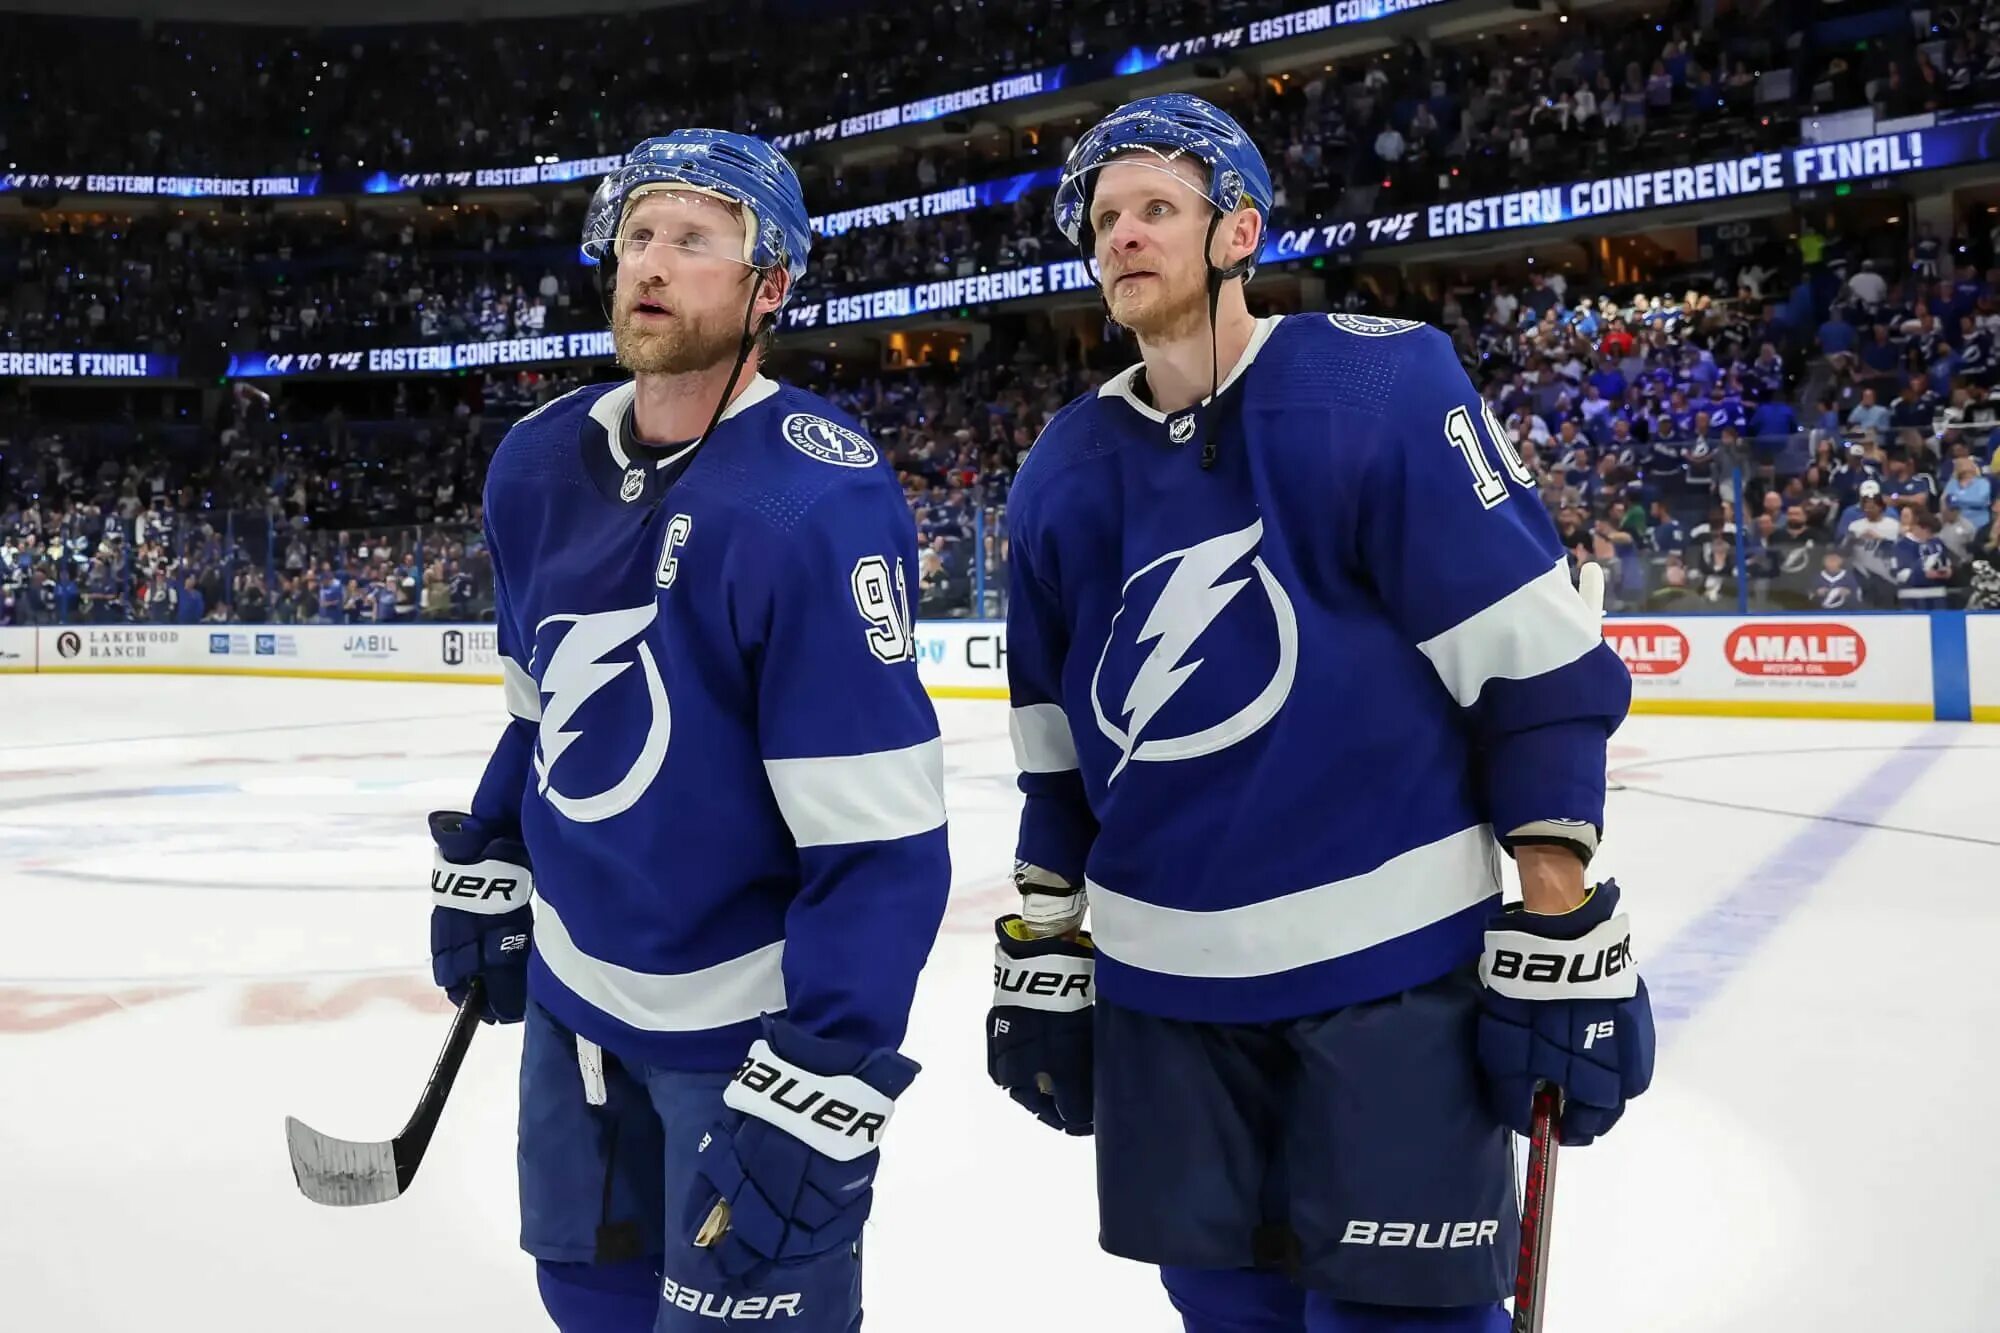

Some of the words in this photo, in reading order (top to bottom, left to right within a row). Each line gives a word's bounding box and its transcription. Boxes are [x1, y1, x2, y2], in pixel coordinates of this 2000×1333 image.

[1184, 37, 1201, 54] TO
[1212, 26, 1244, 47] THE
[1249, 4, 1332, 43] EASTERN
[814, 123, 841, 141] THE
[840, 107, 900, 138] EASTERN
[902, 85, 990, 123] CONFERENCE
[992, 72, 1043, 102] FINAL!
[54, 175, 82, 190] THE
[86, 174, 154, 194] EASTERN
[157, 177, 249, 196] CONFERENCE
[253, 177, 299, 195] FINAL!
[447, 171, 472, 186] THE
[476, 166, 538, 187] EASTERN
[541, 155, 622, 182] CONFERENCE
[922, 185, 977, 217] FINAL!
[1278, 228, 1315, 254] ON
[1322, 221, 1356, 248] TO
[1366, 211, 1419, 242] THE
[1428, 186, 1562, 237] EASTERN
[1570, 153, 1784, 216] CONFERENCE
[1793, 132, 1924, 184] FINAL!
[789, 303, 822, 327] THE
[826, 286, 910, 325] EASTERN
[914, 267, 1044, 311] CONFERENCE
[1049, 258, 1101, 292] FINA
[0, 352, 73, 376] ERENCE
[79, 353, 147, 376] FINAL!
[265, 354, 291, 372] ON
[298, 354, 321, 371] TO
[328, 351, 364, 371] THE
[369, 345, 452, 371] EASTERN
[455, 336, 564, 366] CONFERENCE
[568, 332, 615, 357] FINA
[656, 513, 692, 589] C
[90, 631, 179, 644] LAKEWOOD
[90, 646, 147, 657] RANCH
[343, 635, 399, 652] JABIL
[1733, 635, 1858, 664] AMALIE
